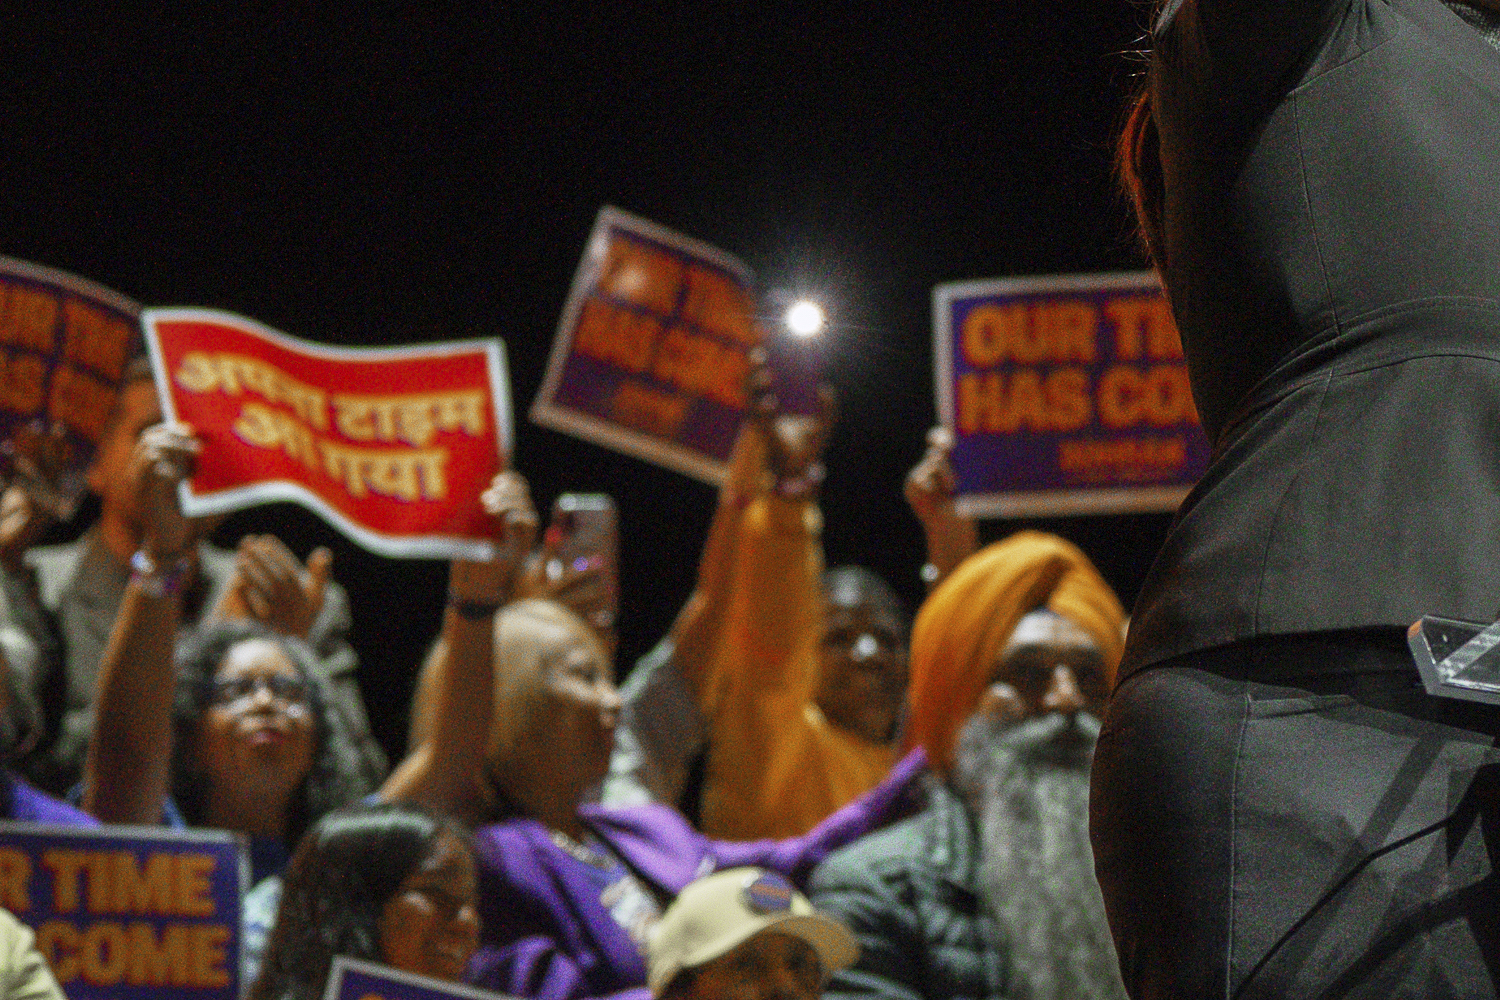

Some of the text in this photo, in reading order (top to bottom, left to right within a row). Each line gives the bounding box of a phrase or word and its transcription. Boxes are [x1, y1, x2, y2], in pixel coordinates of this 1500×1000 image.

[961, 302, 1098, 367] OUR
[174, 351, 328, 432] अपना
[332, 387, 487, 447] टाइम
[957, 364, 1199, 435] HAS CO
[233, 402, 450, 500] आ गया
[42, 850, 216, 917] TIME
[36, 920, 230, 987] COME
